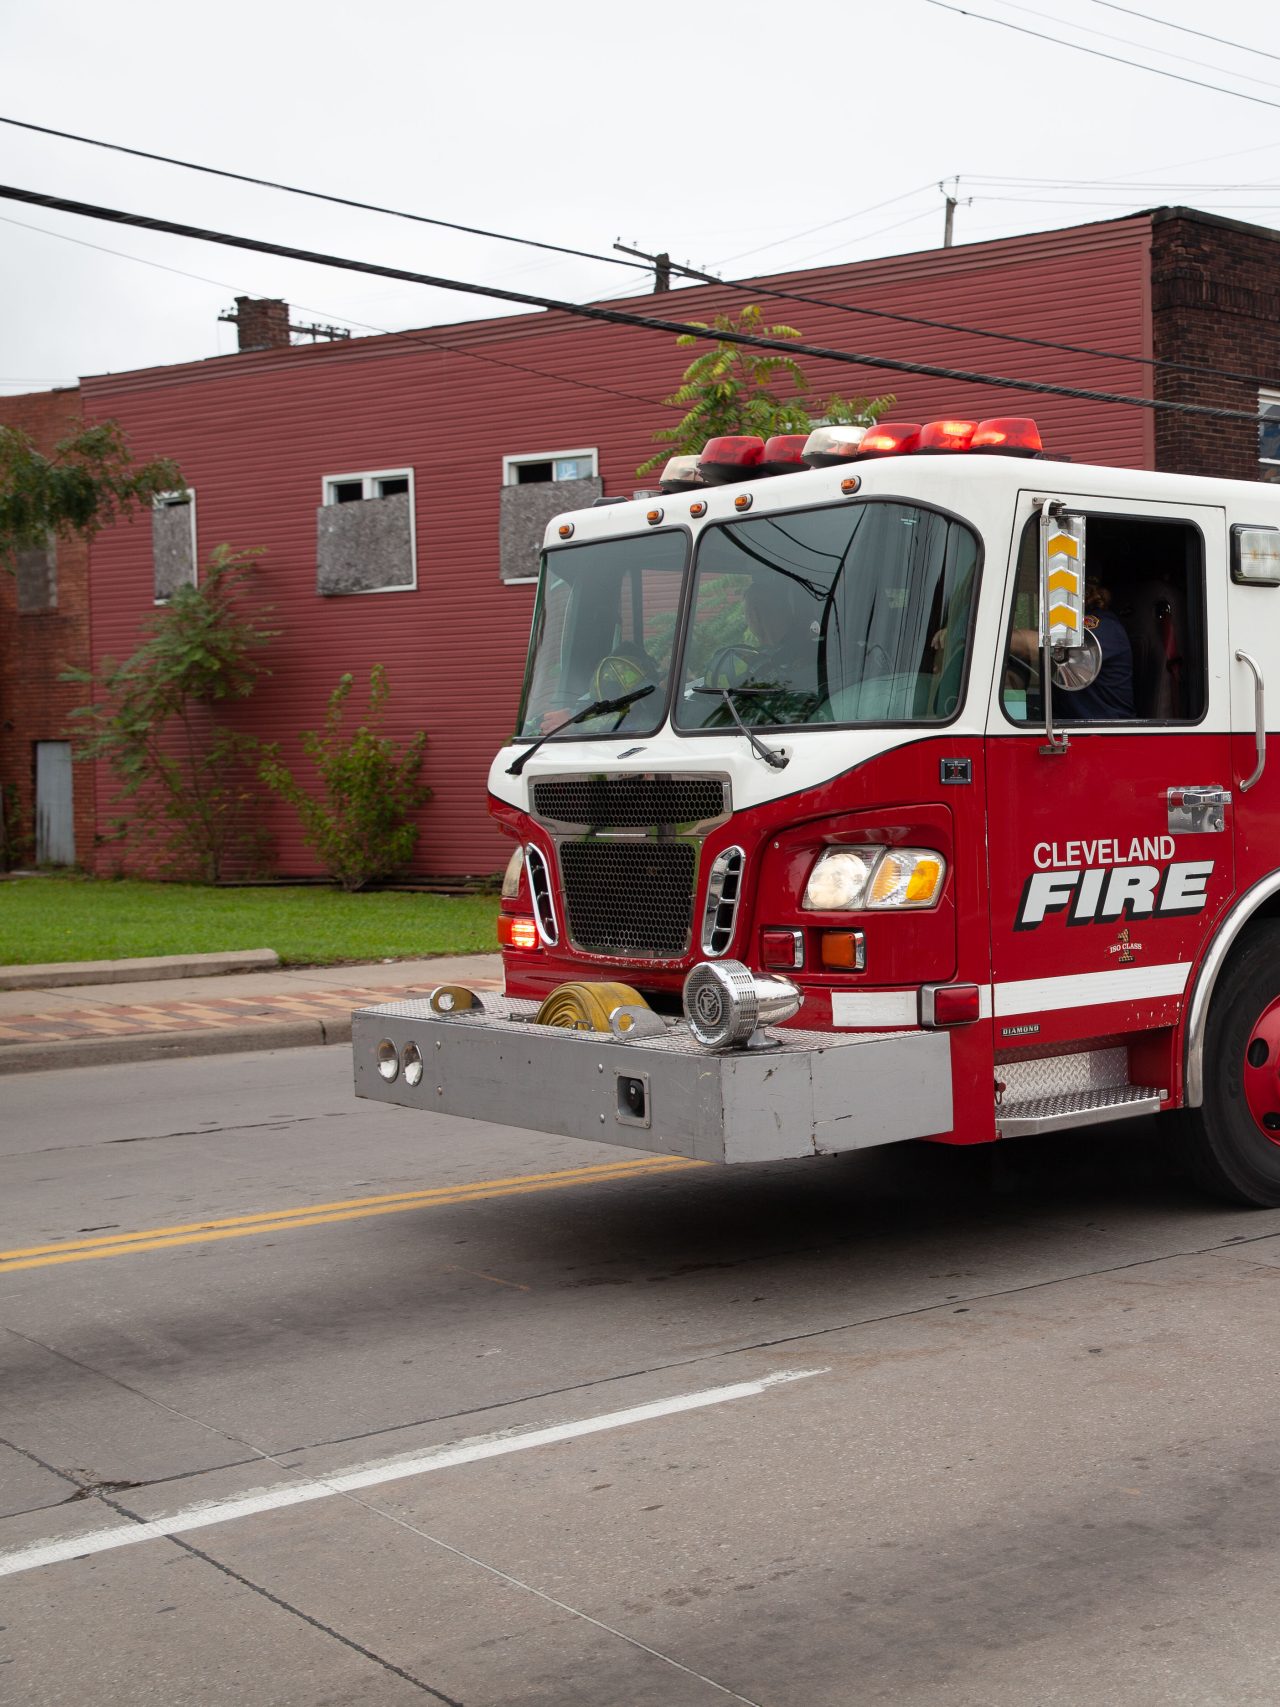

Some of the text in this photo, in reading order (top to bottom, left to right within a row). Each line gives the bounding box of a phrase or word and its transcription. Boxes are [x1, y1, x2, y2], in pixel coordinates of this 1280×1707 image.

[1033, 835, 1176, 869] CLEVELAND
[1015, 860, 1215, 930] FIRE
[1109, 942, 1142, 954] ISO CLASS
[1002, 1024, 1040, 1036] DIAMOND
